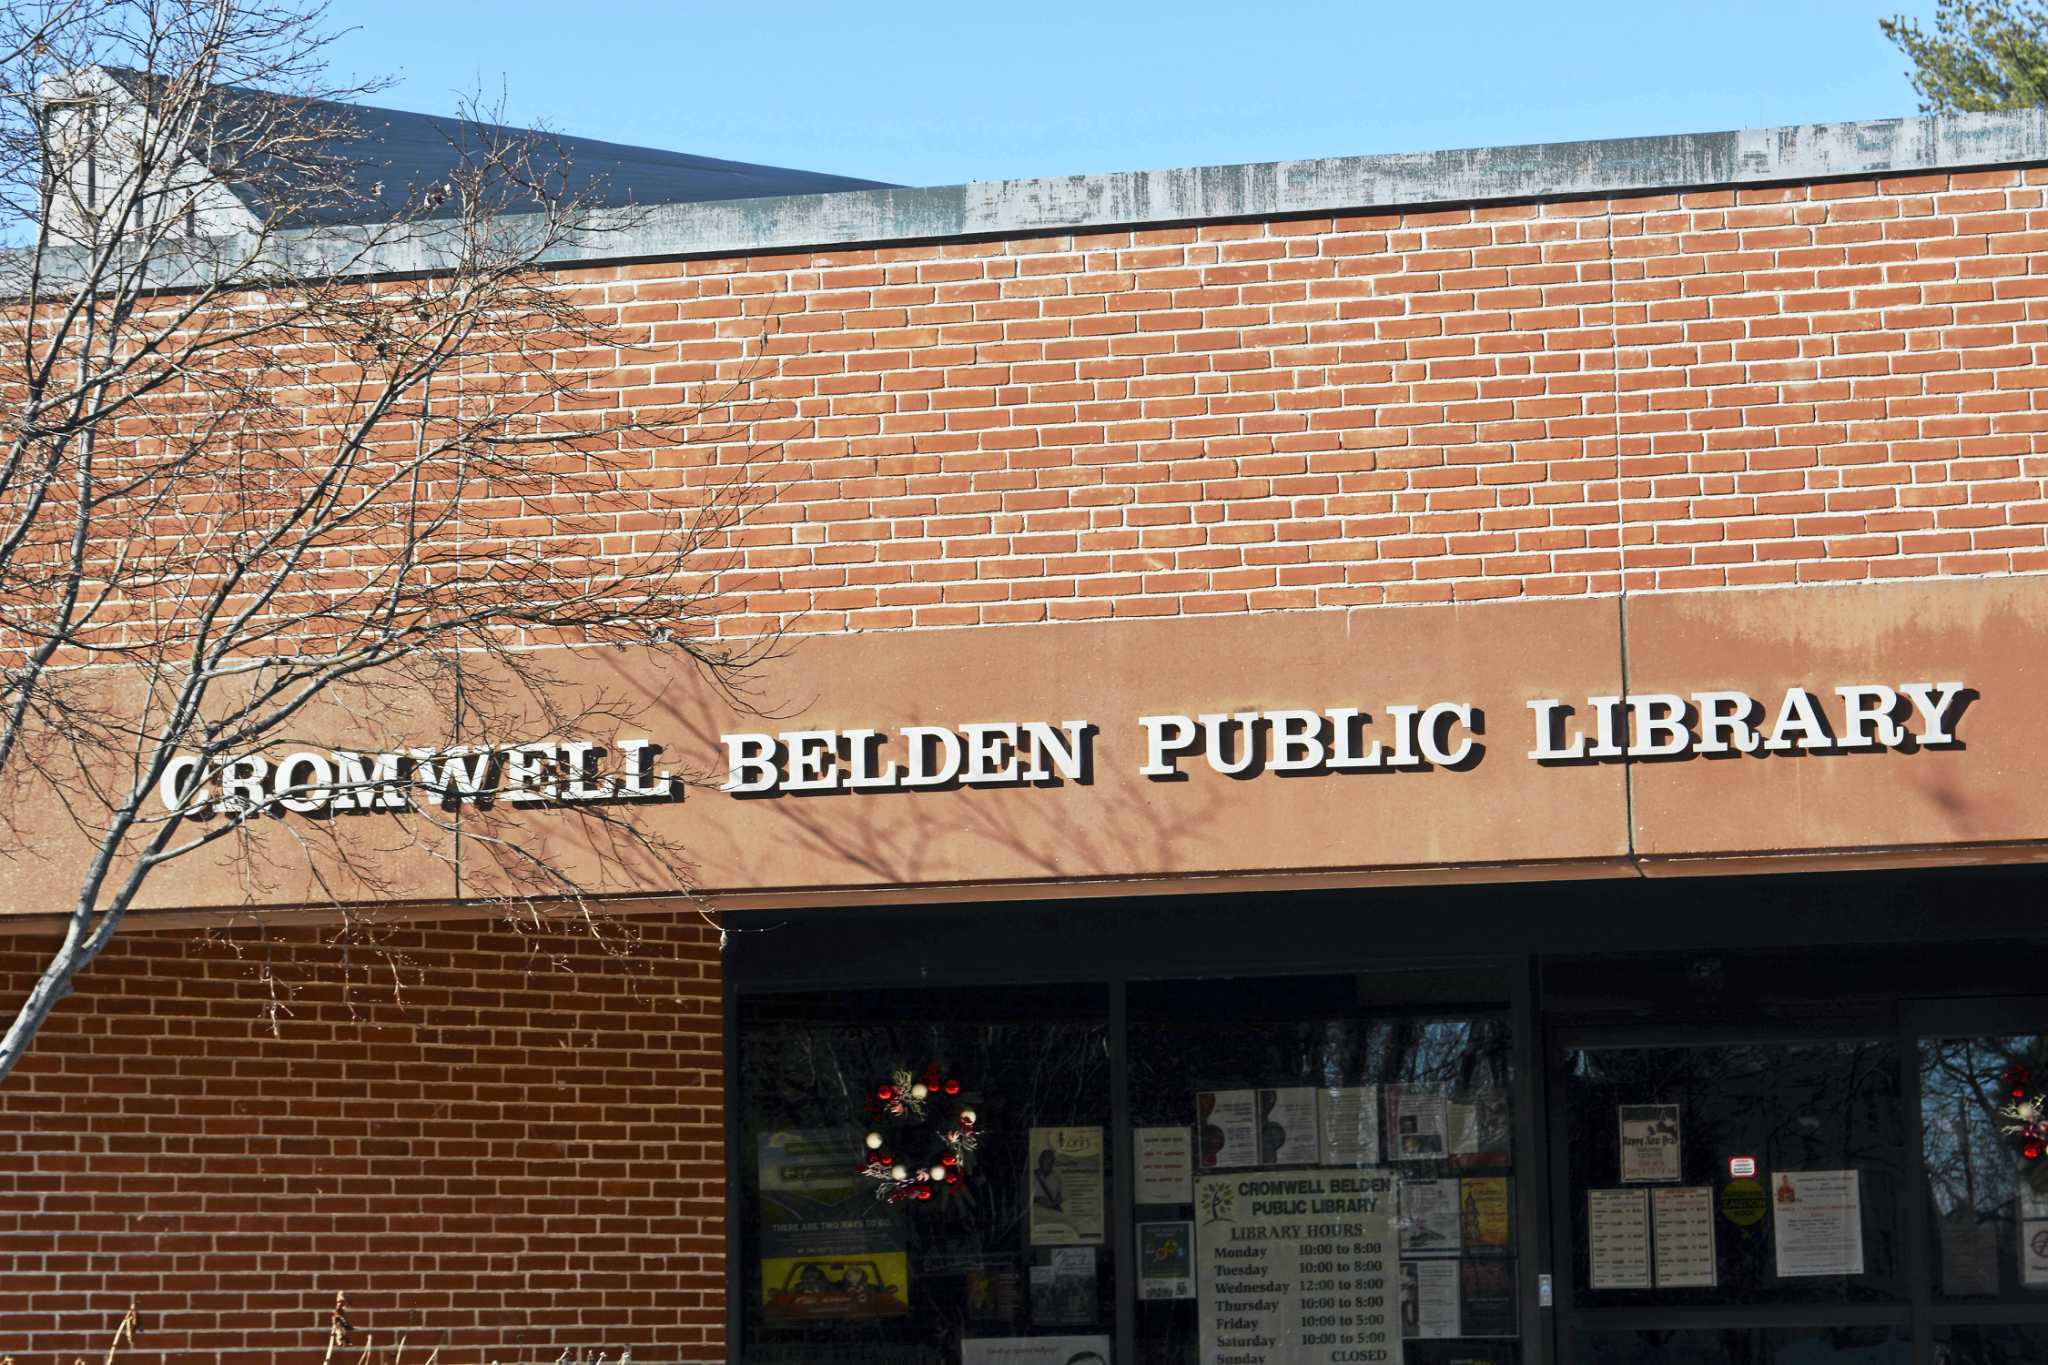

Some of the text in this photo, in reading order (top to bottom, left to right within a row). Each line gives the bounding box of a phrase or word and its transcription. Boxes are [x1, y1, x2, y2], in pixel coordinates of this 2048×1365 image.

[160, 682, 1964, 815] CROMWELL BELDEN PUBLIC LIBRARY
[1238, 1178, 1391, 1196] CROMWELL BELDEN
[1252, 1197, 1378, 1216] PUBLIC LIBRARY
[1231, 1223, 1363, 1241] LIBRARY HOURS
[1214, 1242, 1382, 1260] Monday 10:00 to 8:00
[1215, 1260, 1383, 1279] Tuesday 10:00 to 8:00
[1215, 1278, 1384, 1295] Wednesday 12:00 to 8:00
[1215, 1296, 1384, 1313] Thursday 10:00 to 8:00
[1216, 1314, 1385, 1331] Friday 10:00 to 5:00
[1217, 1332, 1386, 1349] Saturday 10:00 to 5:00
[1217, 1350, 1388, 1365] Sunday CLOSED
